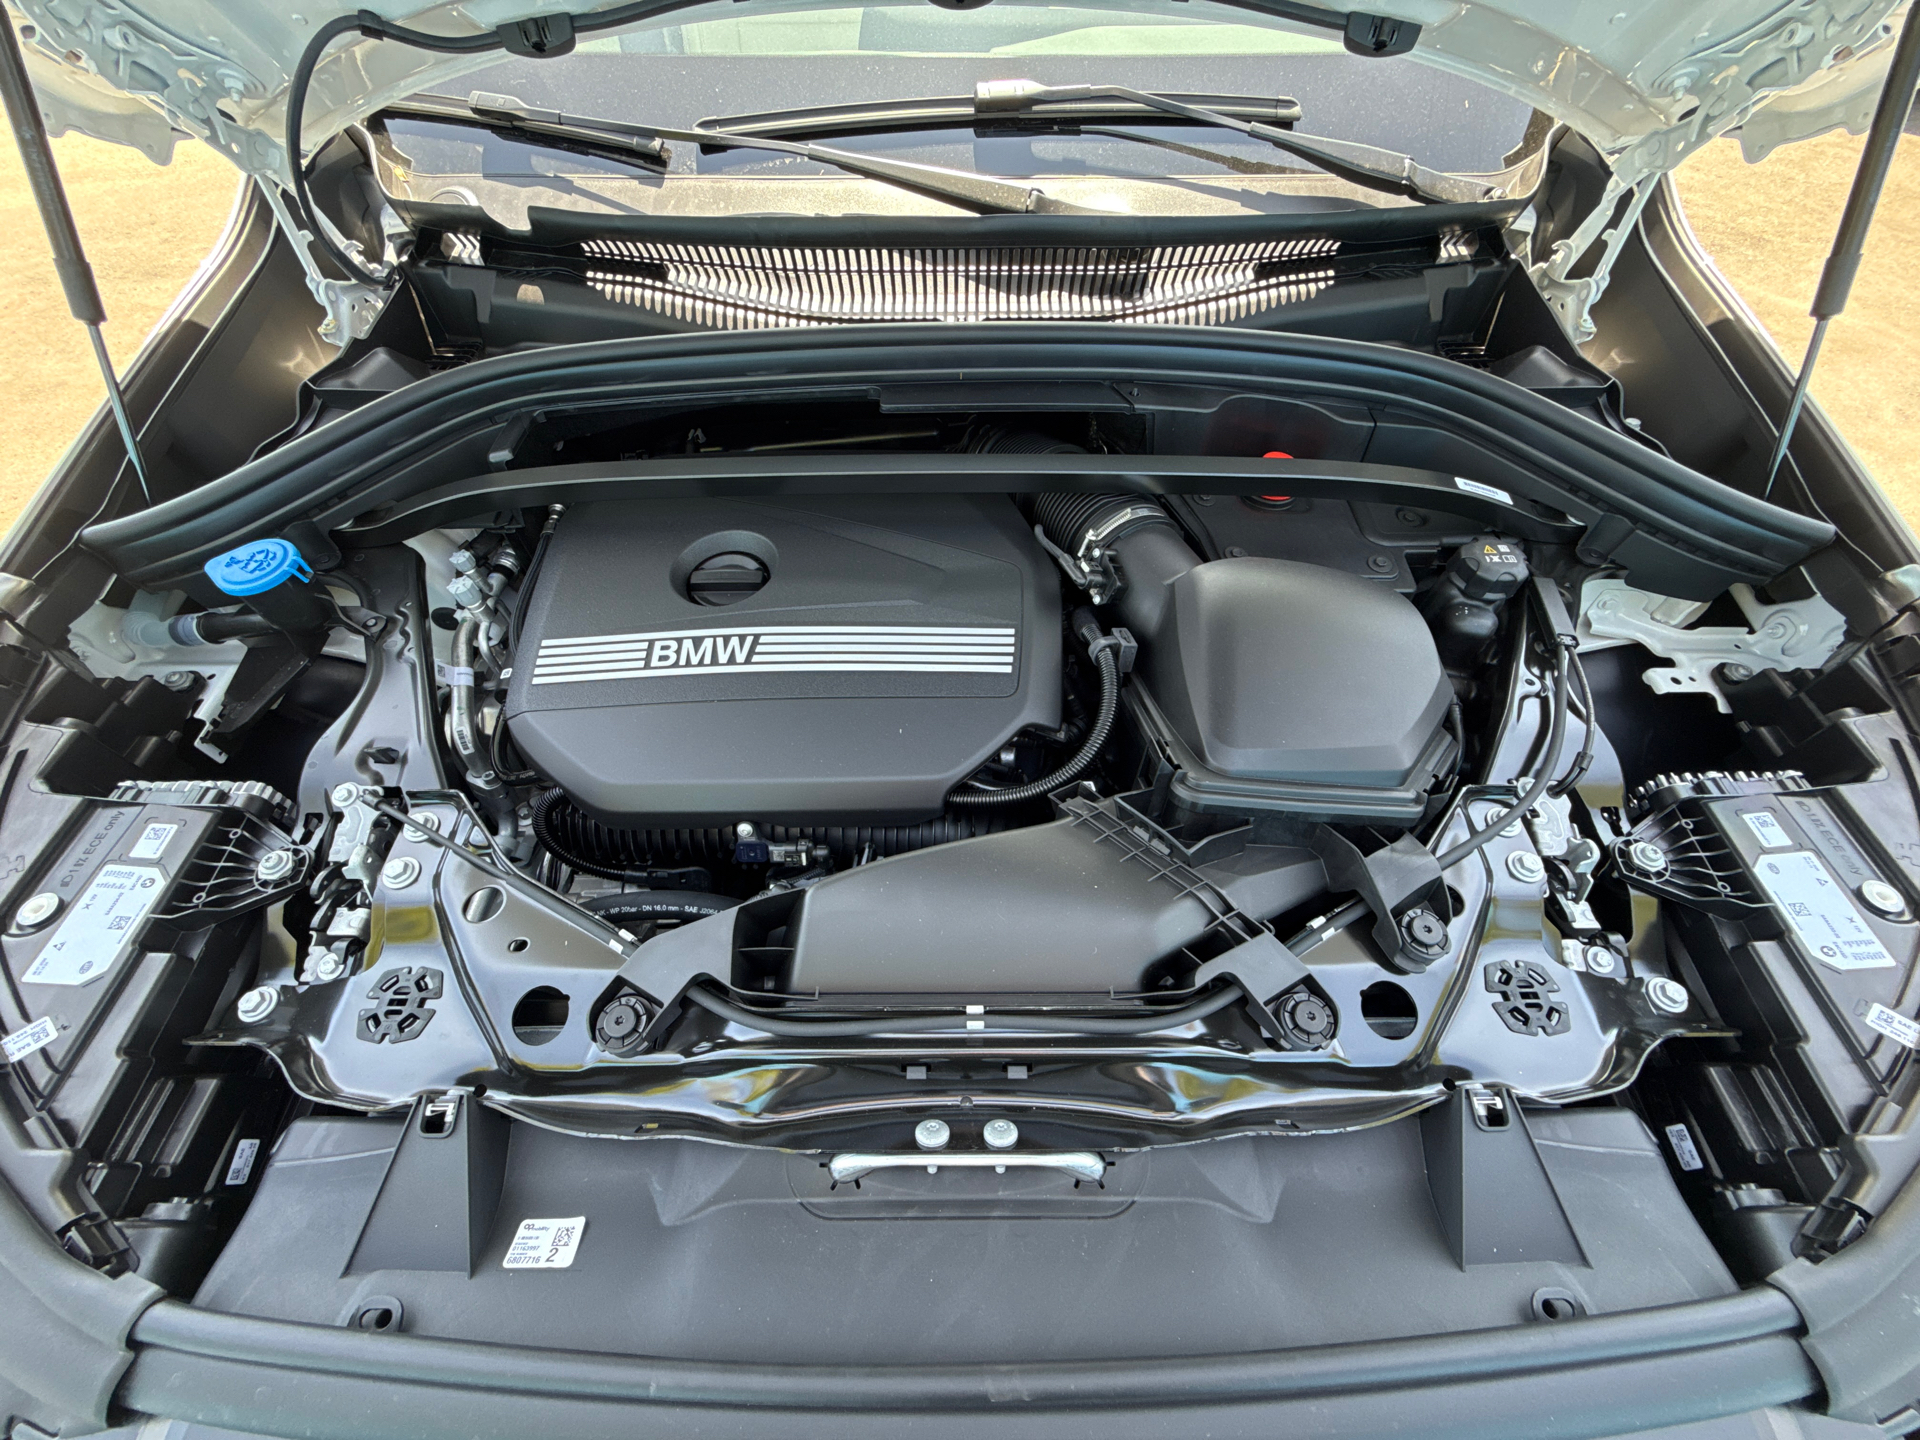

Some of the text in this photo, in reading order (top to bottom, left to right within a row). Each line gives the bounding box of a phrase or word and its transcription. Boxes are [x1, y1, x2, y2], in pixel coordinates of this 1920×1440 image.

[650, 635, 754, 667] BMW
[82, 832, 109, 855] ECE
[104, 810, 126, 831] only
[1821, 830, 1846, 853] ECE
[1841, 854, 1863, 876] only
[609, 907, 620, 915] WP
[684, 905, 699, 913] SAE
[506, 1247, 559, 1265] 6807716 2
